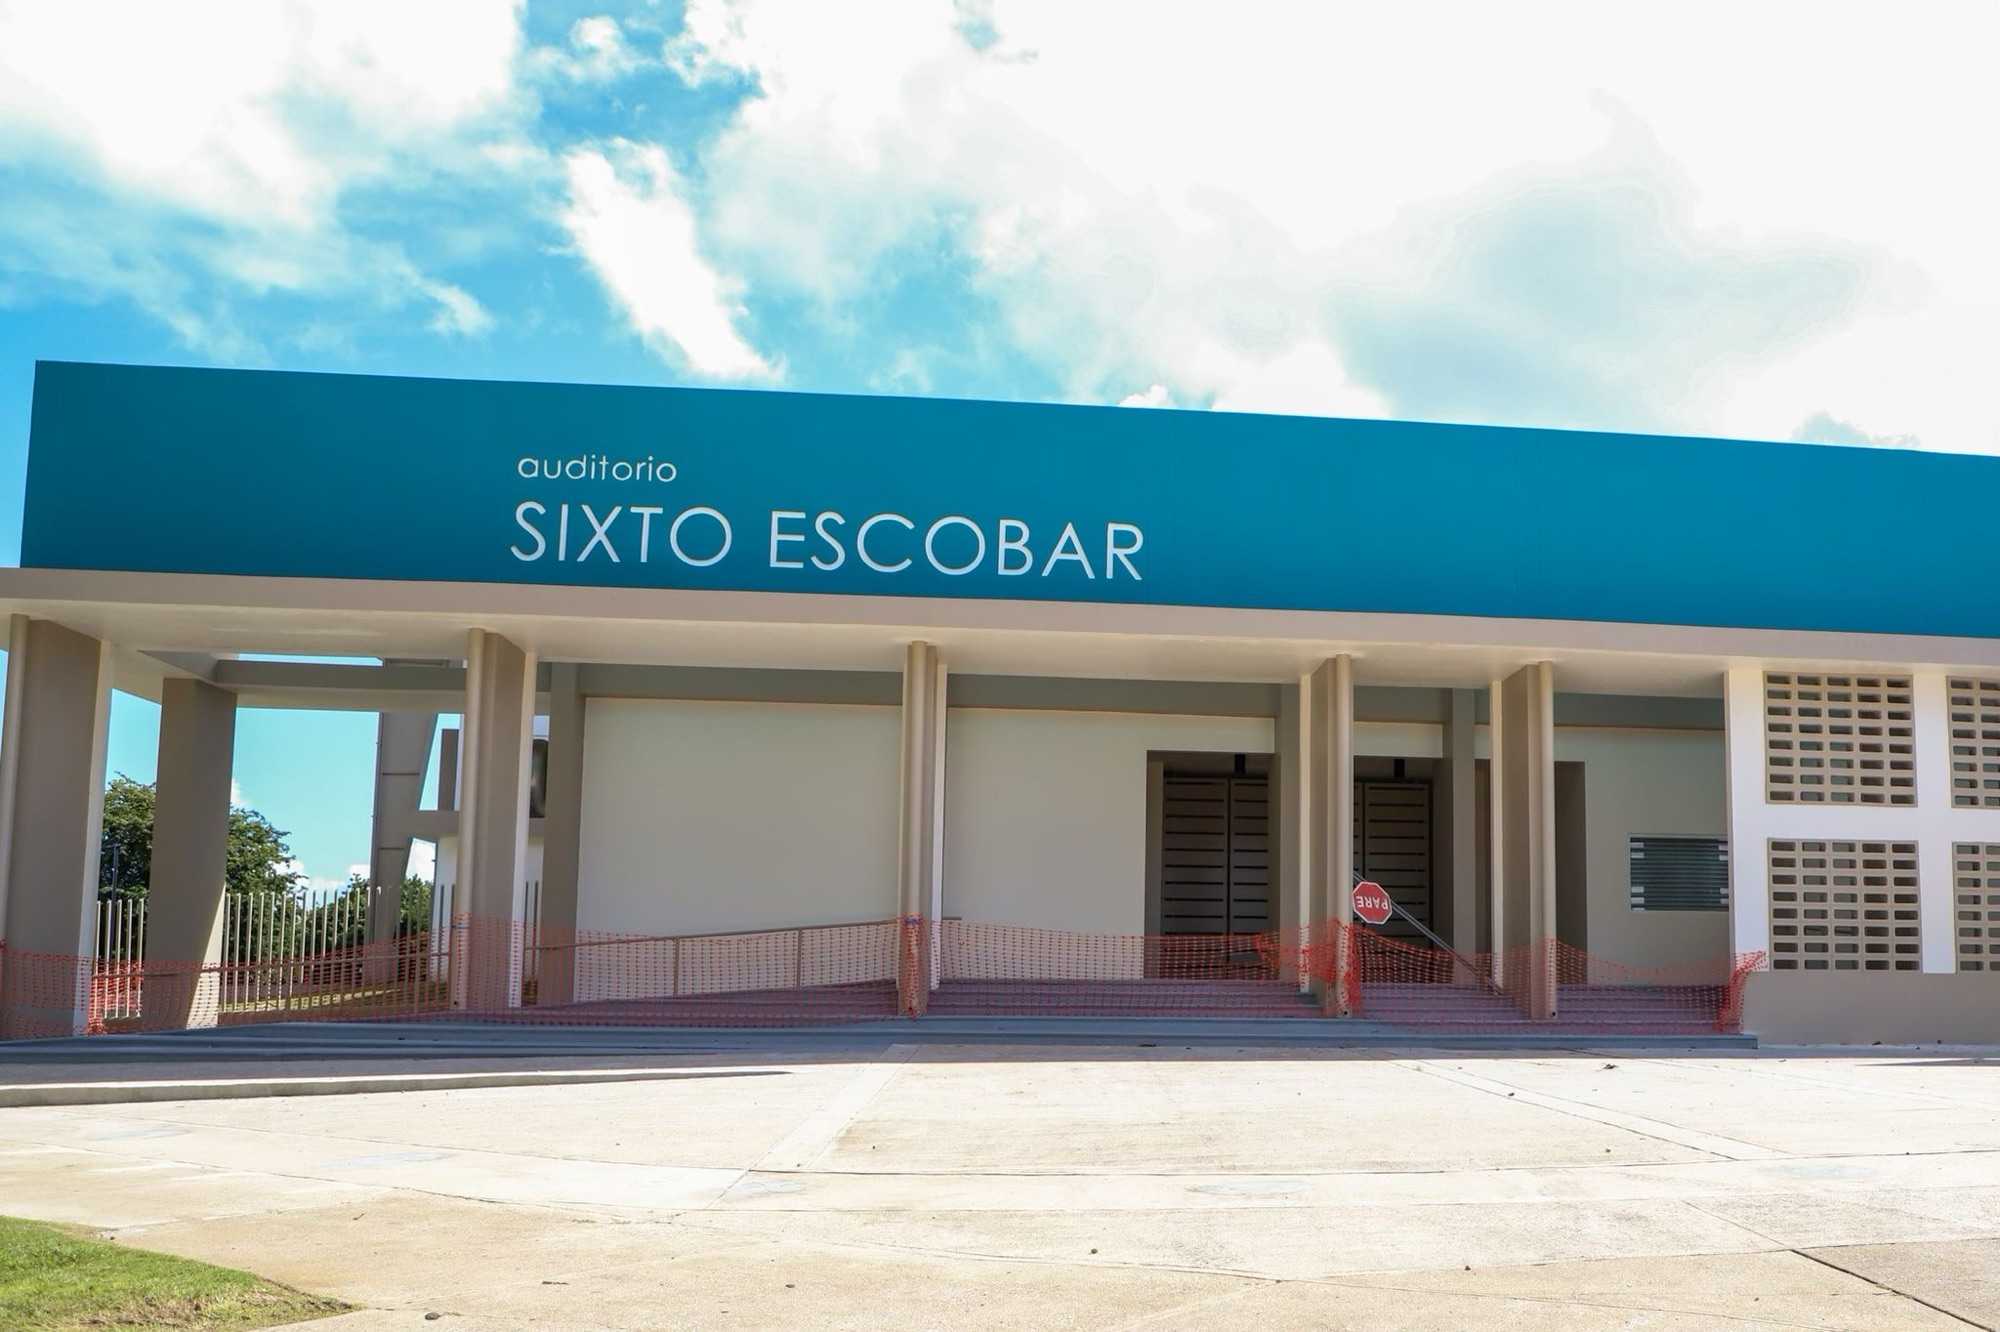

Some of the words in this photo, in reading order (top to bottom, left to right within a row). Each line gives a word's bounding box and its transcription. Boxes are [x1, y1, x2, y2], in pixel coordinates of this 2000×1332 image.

[517, 454, 677, 483] auditorio
[510, 500, 733, 568] SIXTO
[769, 509, 1145, 581] ESCOBAR
[1356, 896, 1389, 910] PARE
